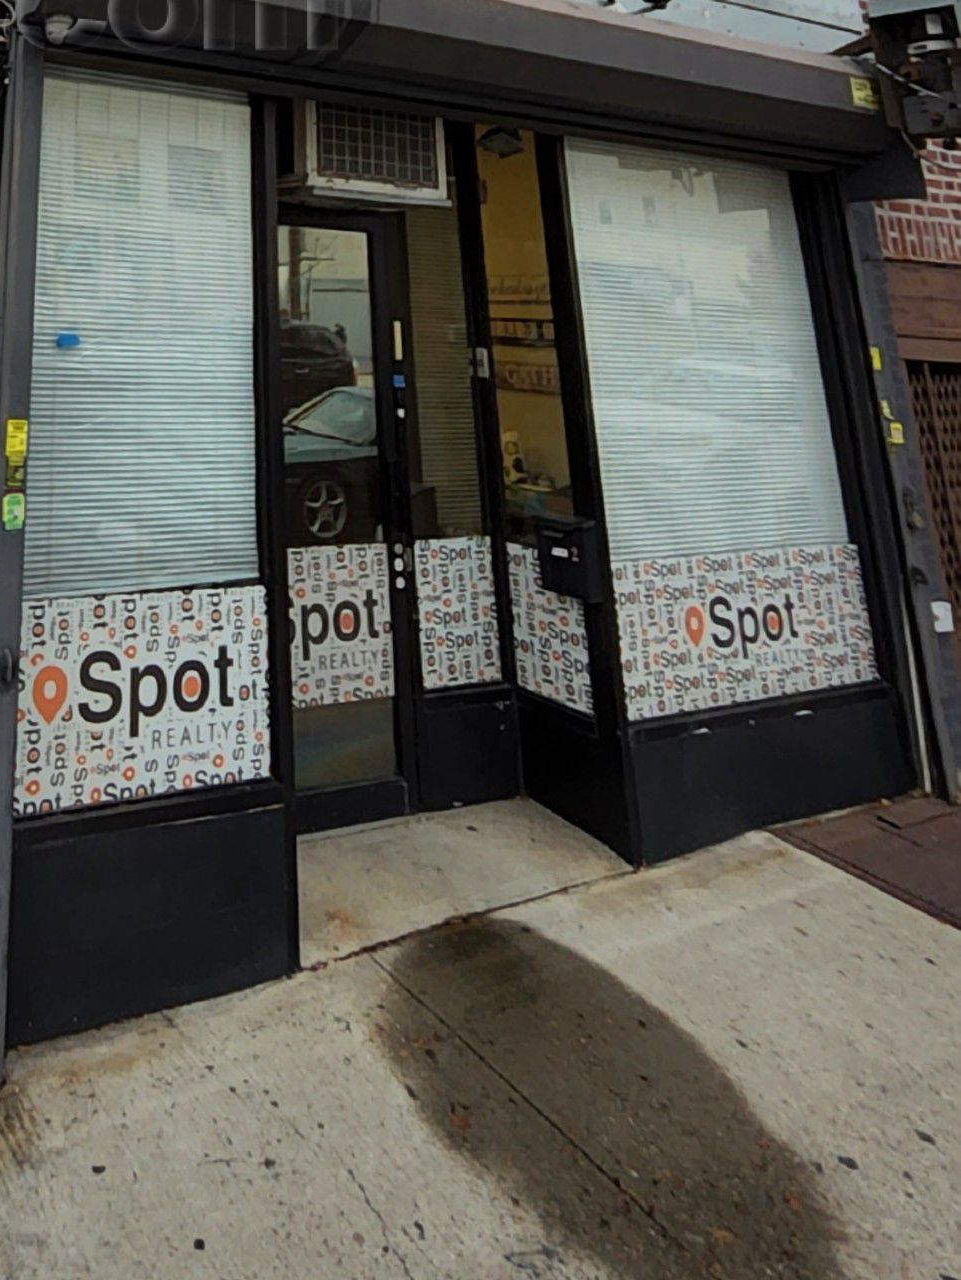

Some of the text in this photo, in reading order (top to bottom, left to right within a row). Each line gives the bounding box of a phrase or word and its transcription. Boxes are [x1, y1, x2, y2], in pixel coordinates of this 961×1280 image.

[438, 545, 474, 566] Spot
[703, 556, 733, 575] Spot
[650, 560, 682, 580] Spot
[663, 583, 695, 604] Spot
[432, 606, 468, 628] Spot
[709, 593, 799, 660] Spot
[444, 630, 479, 652] Spot
[318, 649, 380, 670] REALTY
[660, 648, 694, 671] Spot
[78, 644, 235, 738] Spot
[673, 672, 706, 695] Spot
[151, 720, 233, 751] REALTY
